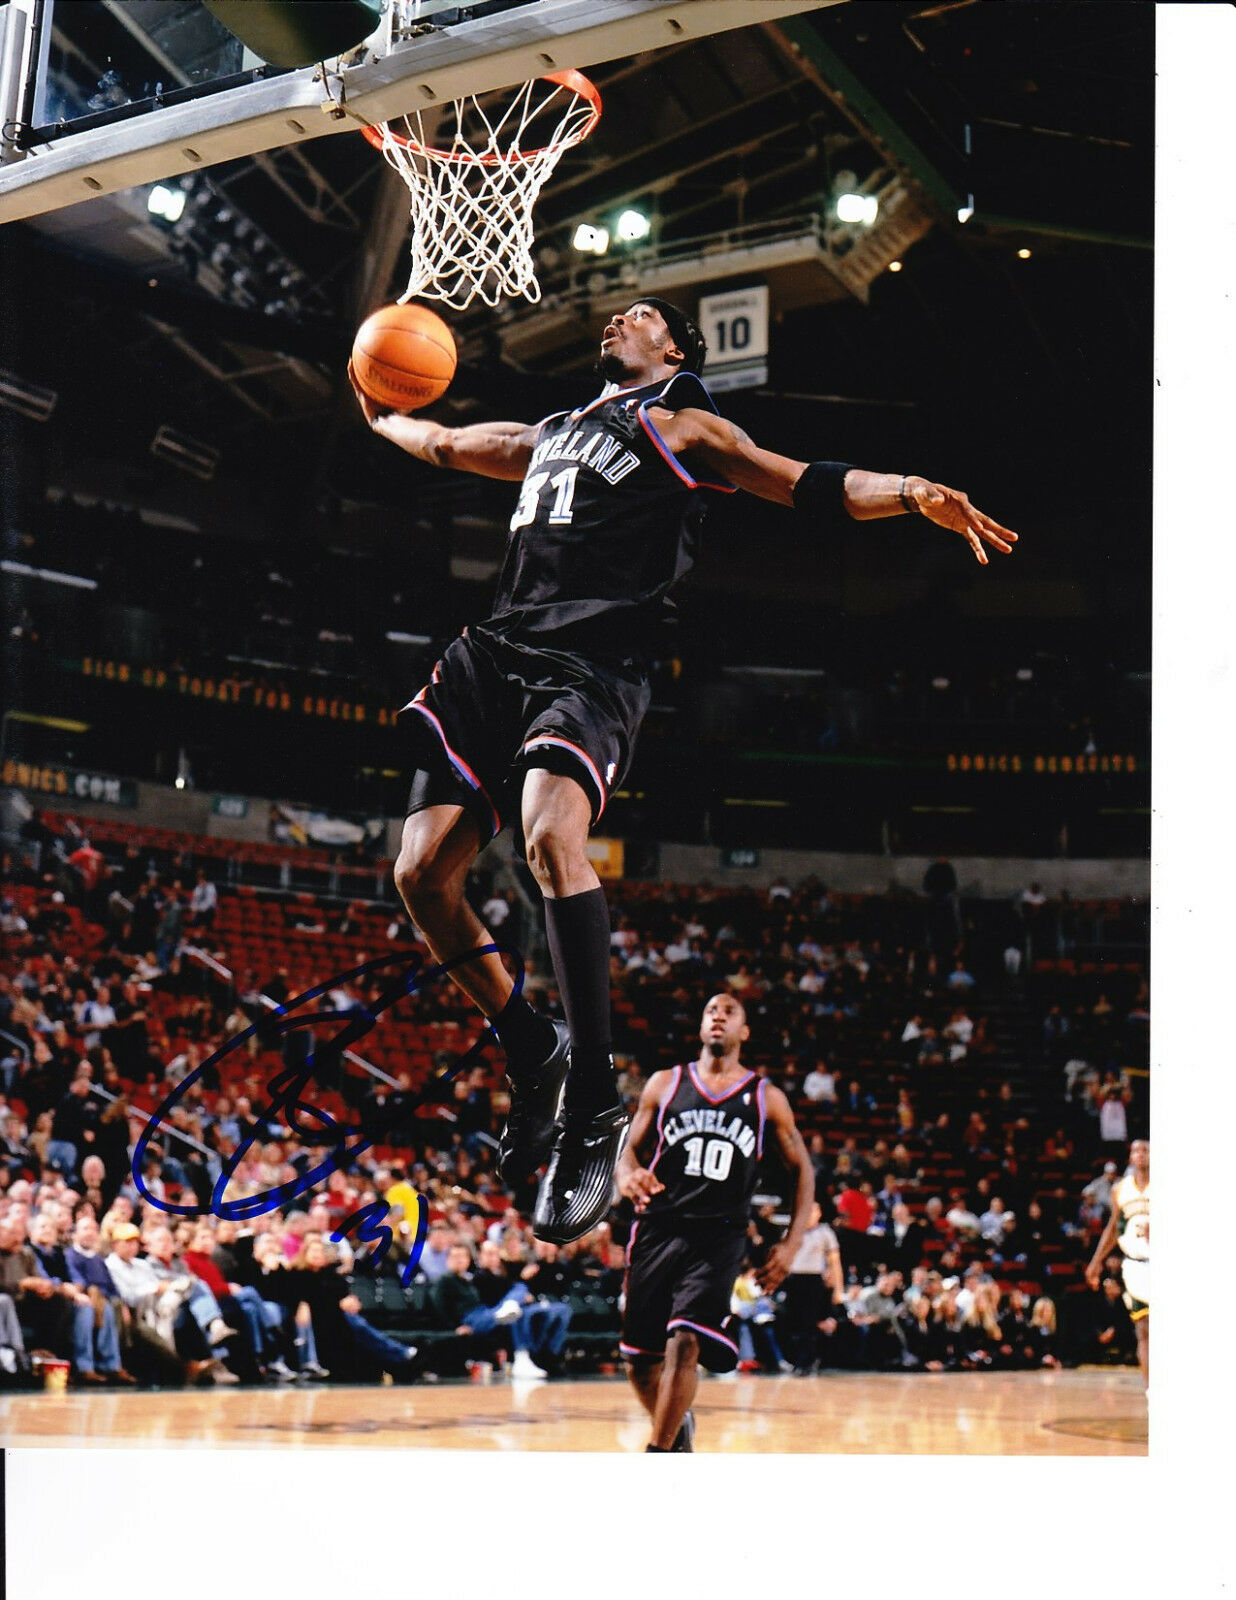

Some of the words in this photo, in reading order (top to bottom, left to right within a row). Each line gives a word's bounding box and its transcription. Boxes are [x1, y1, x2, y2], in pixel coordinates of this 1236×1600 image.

[716, 316, 751, 353] 10
[366, 363, 435, 398] SPALDING
[509, 466, 580, 532] 31
[664, 1108, 756, 1158] CLEVELAND
[683, 1136, 734, 1181] 10
